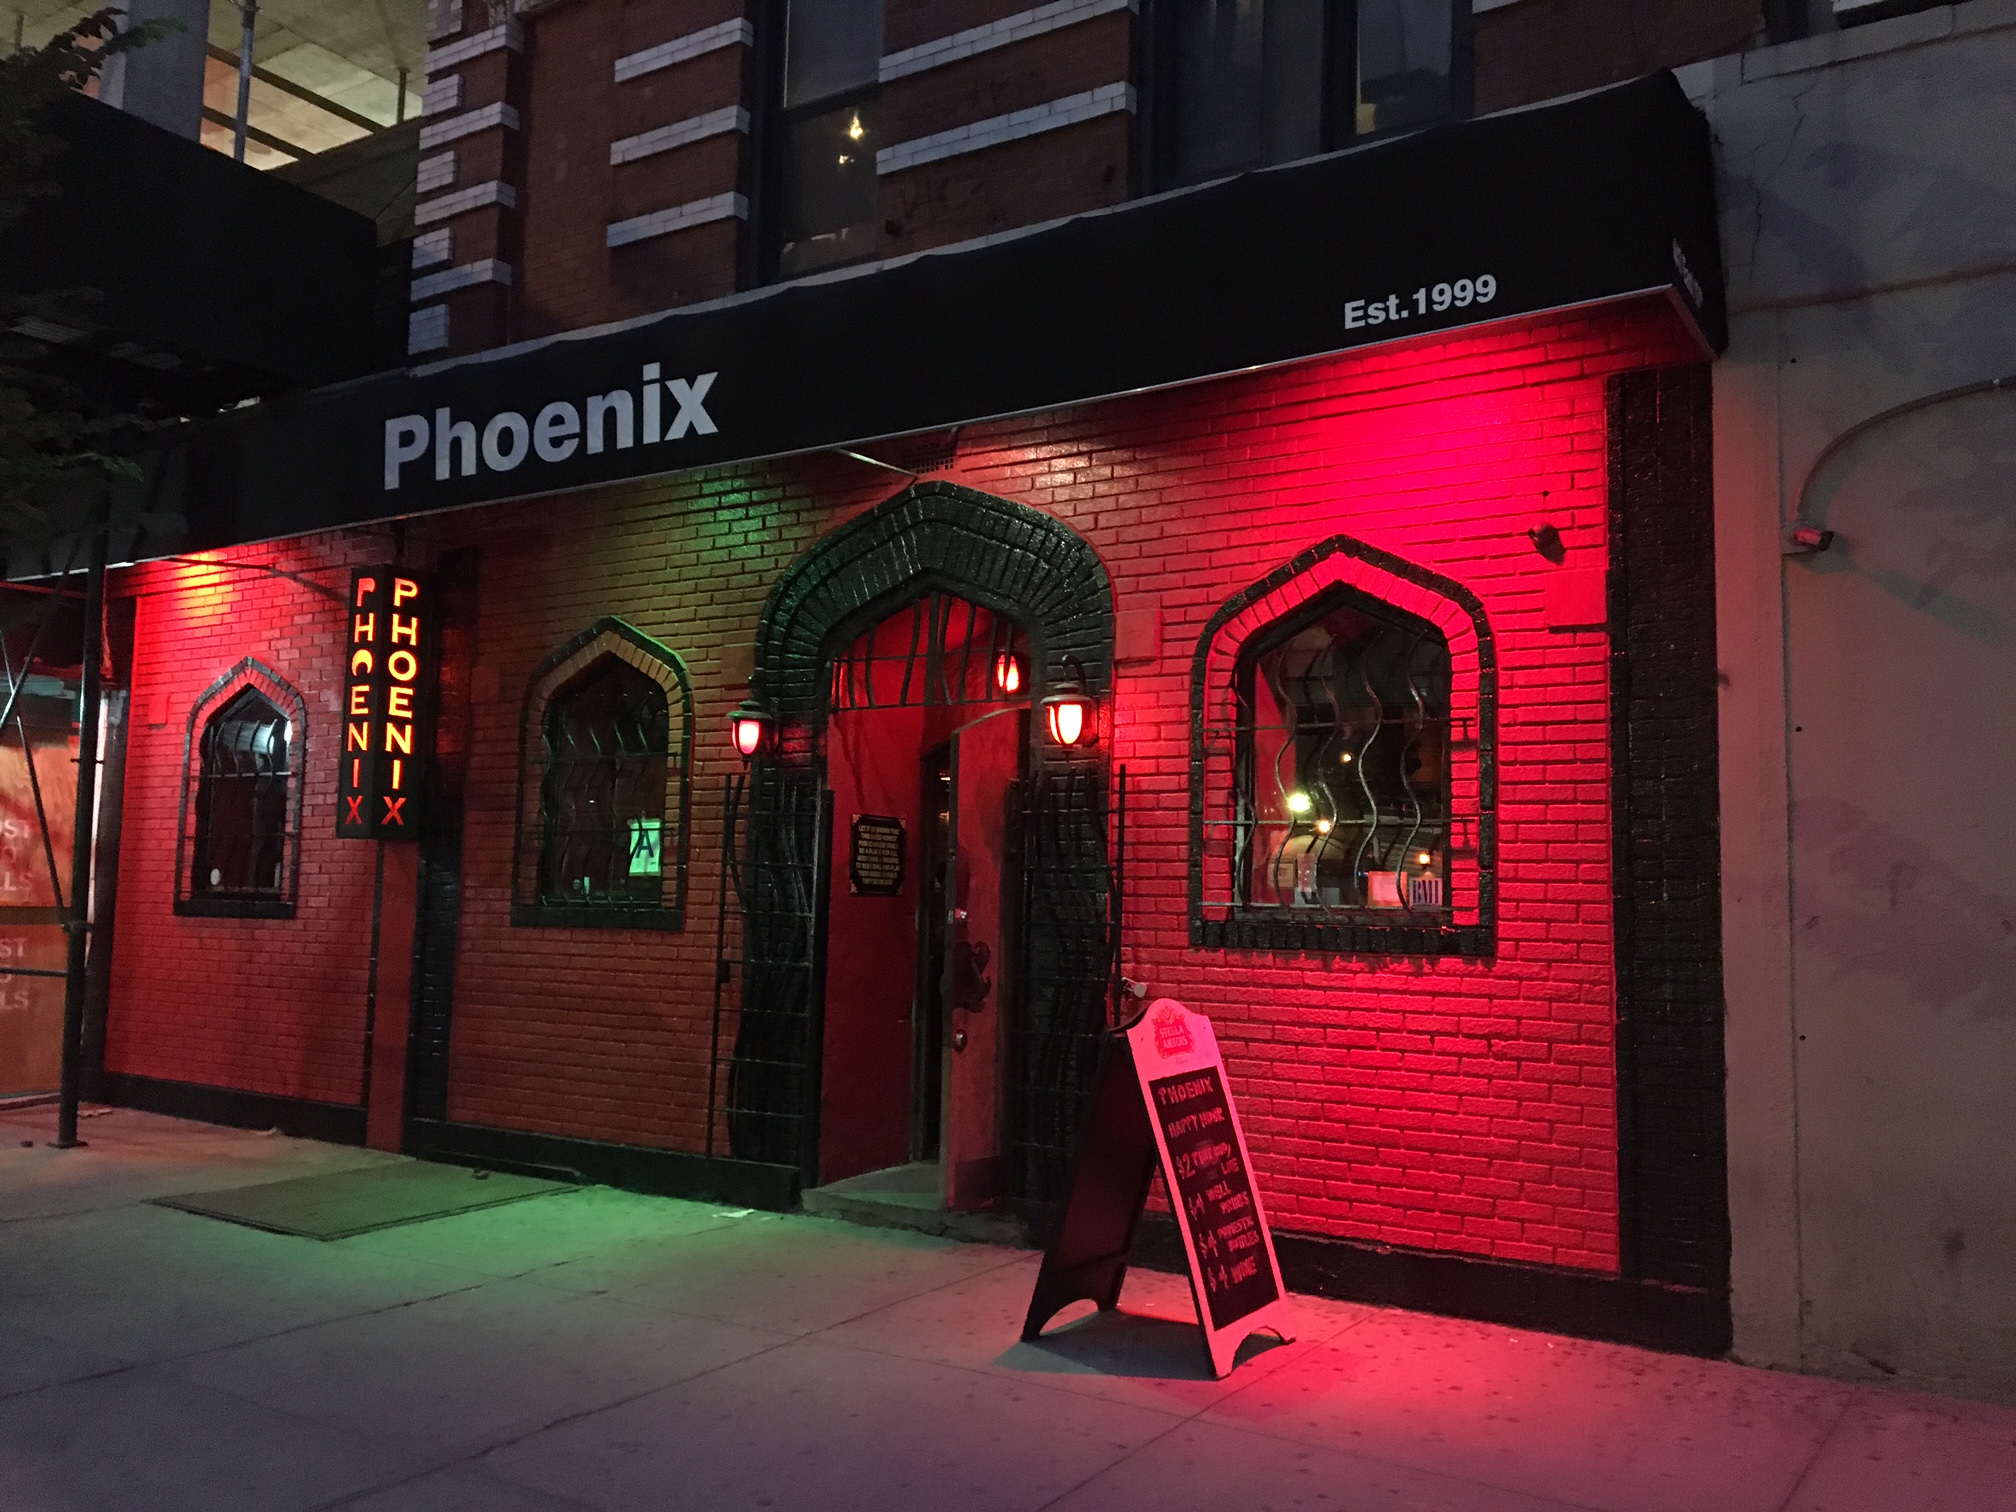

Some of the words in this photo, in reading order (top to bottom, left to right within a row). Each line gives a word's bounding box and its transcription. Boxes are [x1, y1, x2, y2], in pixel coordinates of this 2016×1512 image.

[384, 362, 719, 491] Phoenix
[345, 577, 376, 825] PHOENIX
[381, 577, 419, 826] PHOENIX
[1160, 1025, 1185, 1038] STELLA
[1163, 1035, 1188, 1049] ARTOIS
[1158, 1076, 1213, 1105] PHOENIX
[1168, 1114, 1198, 1138] HAPPY
